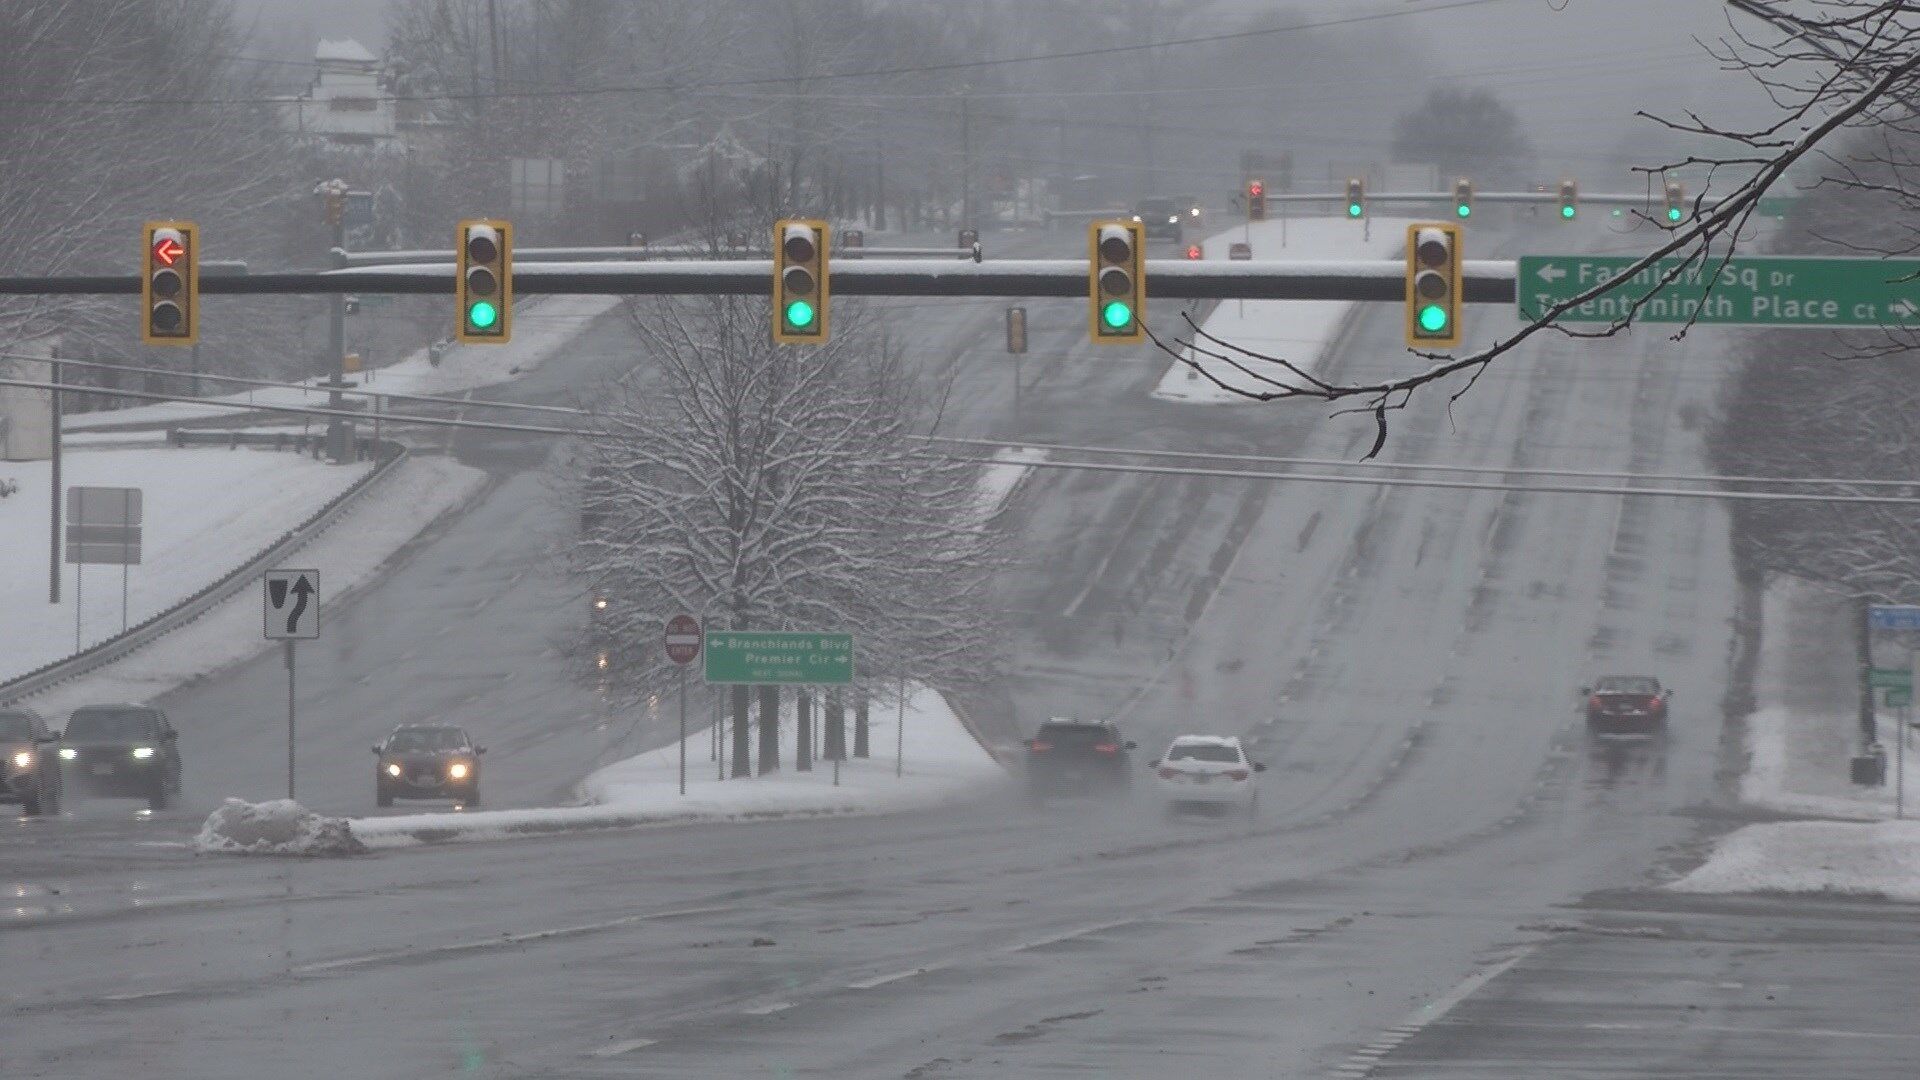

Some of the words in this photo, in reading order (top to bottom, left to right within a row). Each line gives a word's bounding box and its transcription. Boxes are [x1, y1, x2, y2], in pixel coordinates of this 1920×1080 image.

[1722, 264, 1758, 291] Sq
[1769, 271, 1795, 286] Dr
[1752, 296, 1838, 318] Place
[1853, 303, 1877, 319] Ct
[728, 637, 813, 650] Branchlands
[820, 638, 850, 650] Blvd
[745, 653, 801, 665] Premier
[809, 654, 831, 666] Cir
